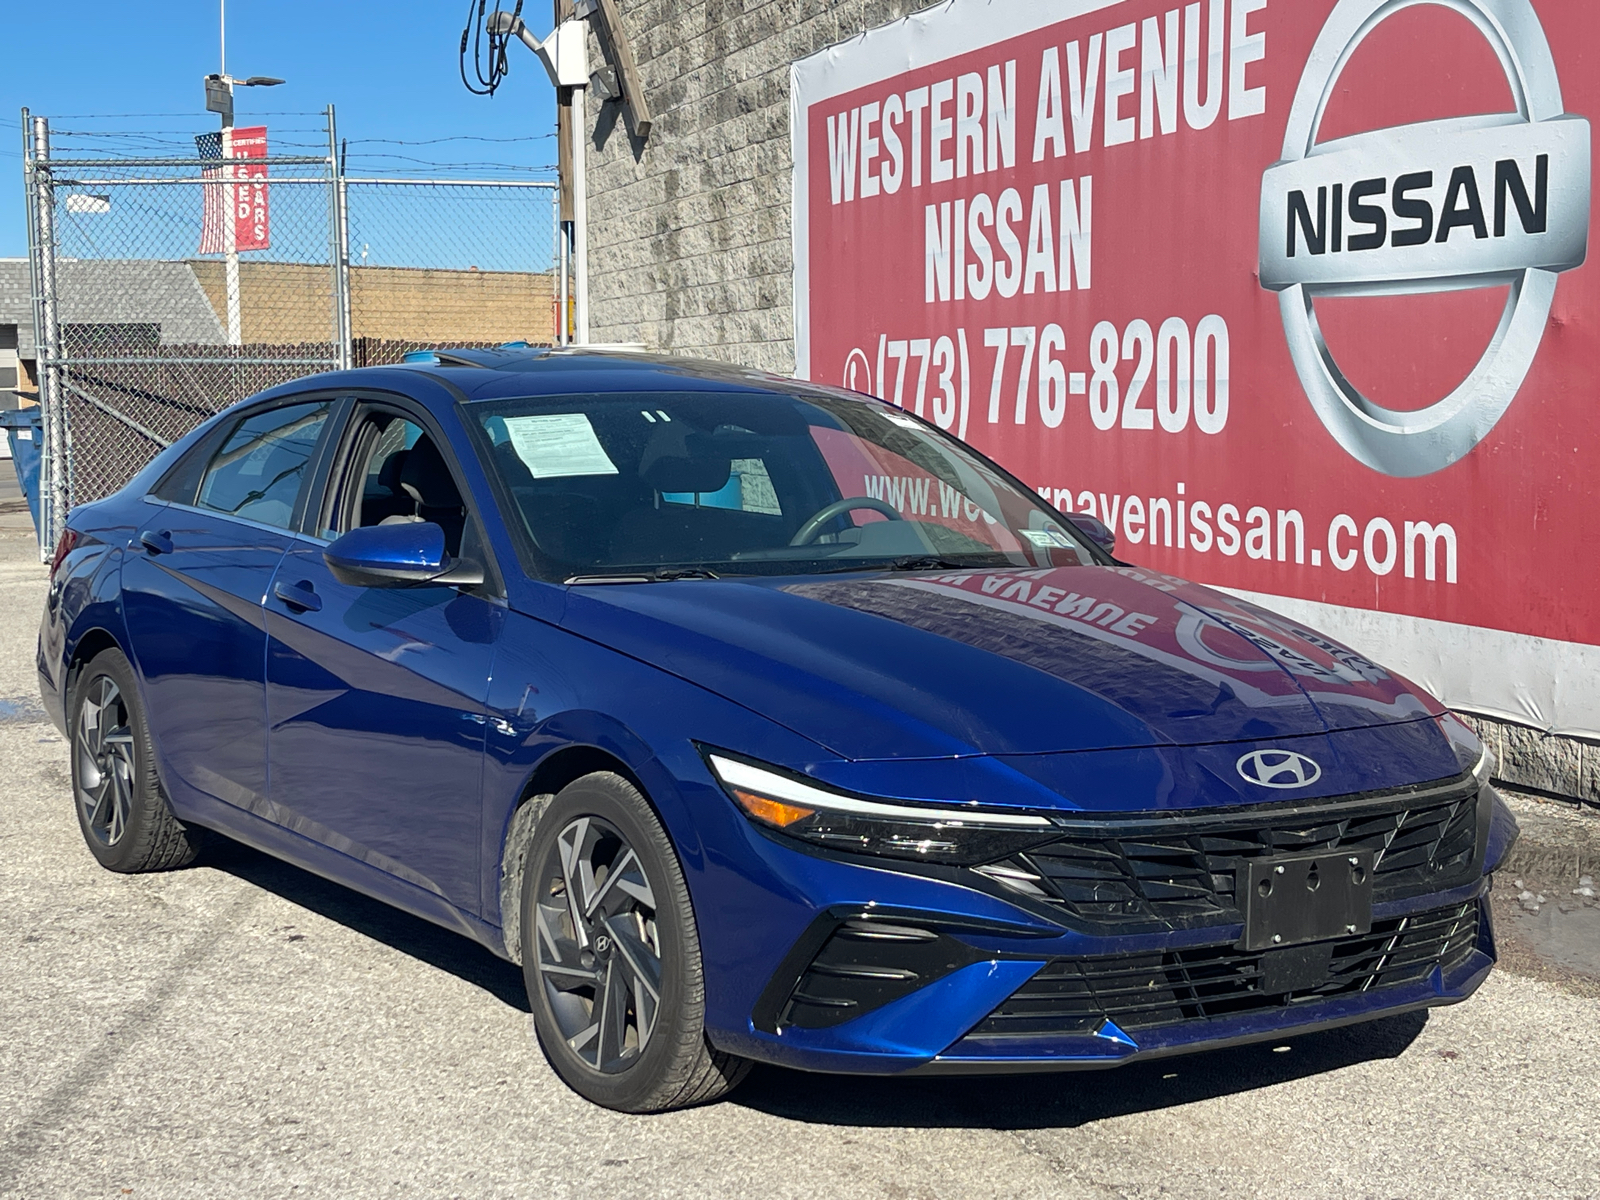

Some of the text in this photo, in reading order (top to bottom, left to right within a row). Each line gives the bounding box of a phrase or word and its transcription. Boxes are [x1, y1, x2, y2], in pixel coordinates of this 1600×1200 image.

[827, 0, 1267, 205] WESTERN AVENUE
[236, 151, 250, 219] USED
[925, 175, 1093, 303] NISSAN
[1286, 154, 1548, 258] NISSAN
[877, 314, 1229, 441] (773) 776-8200
